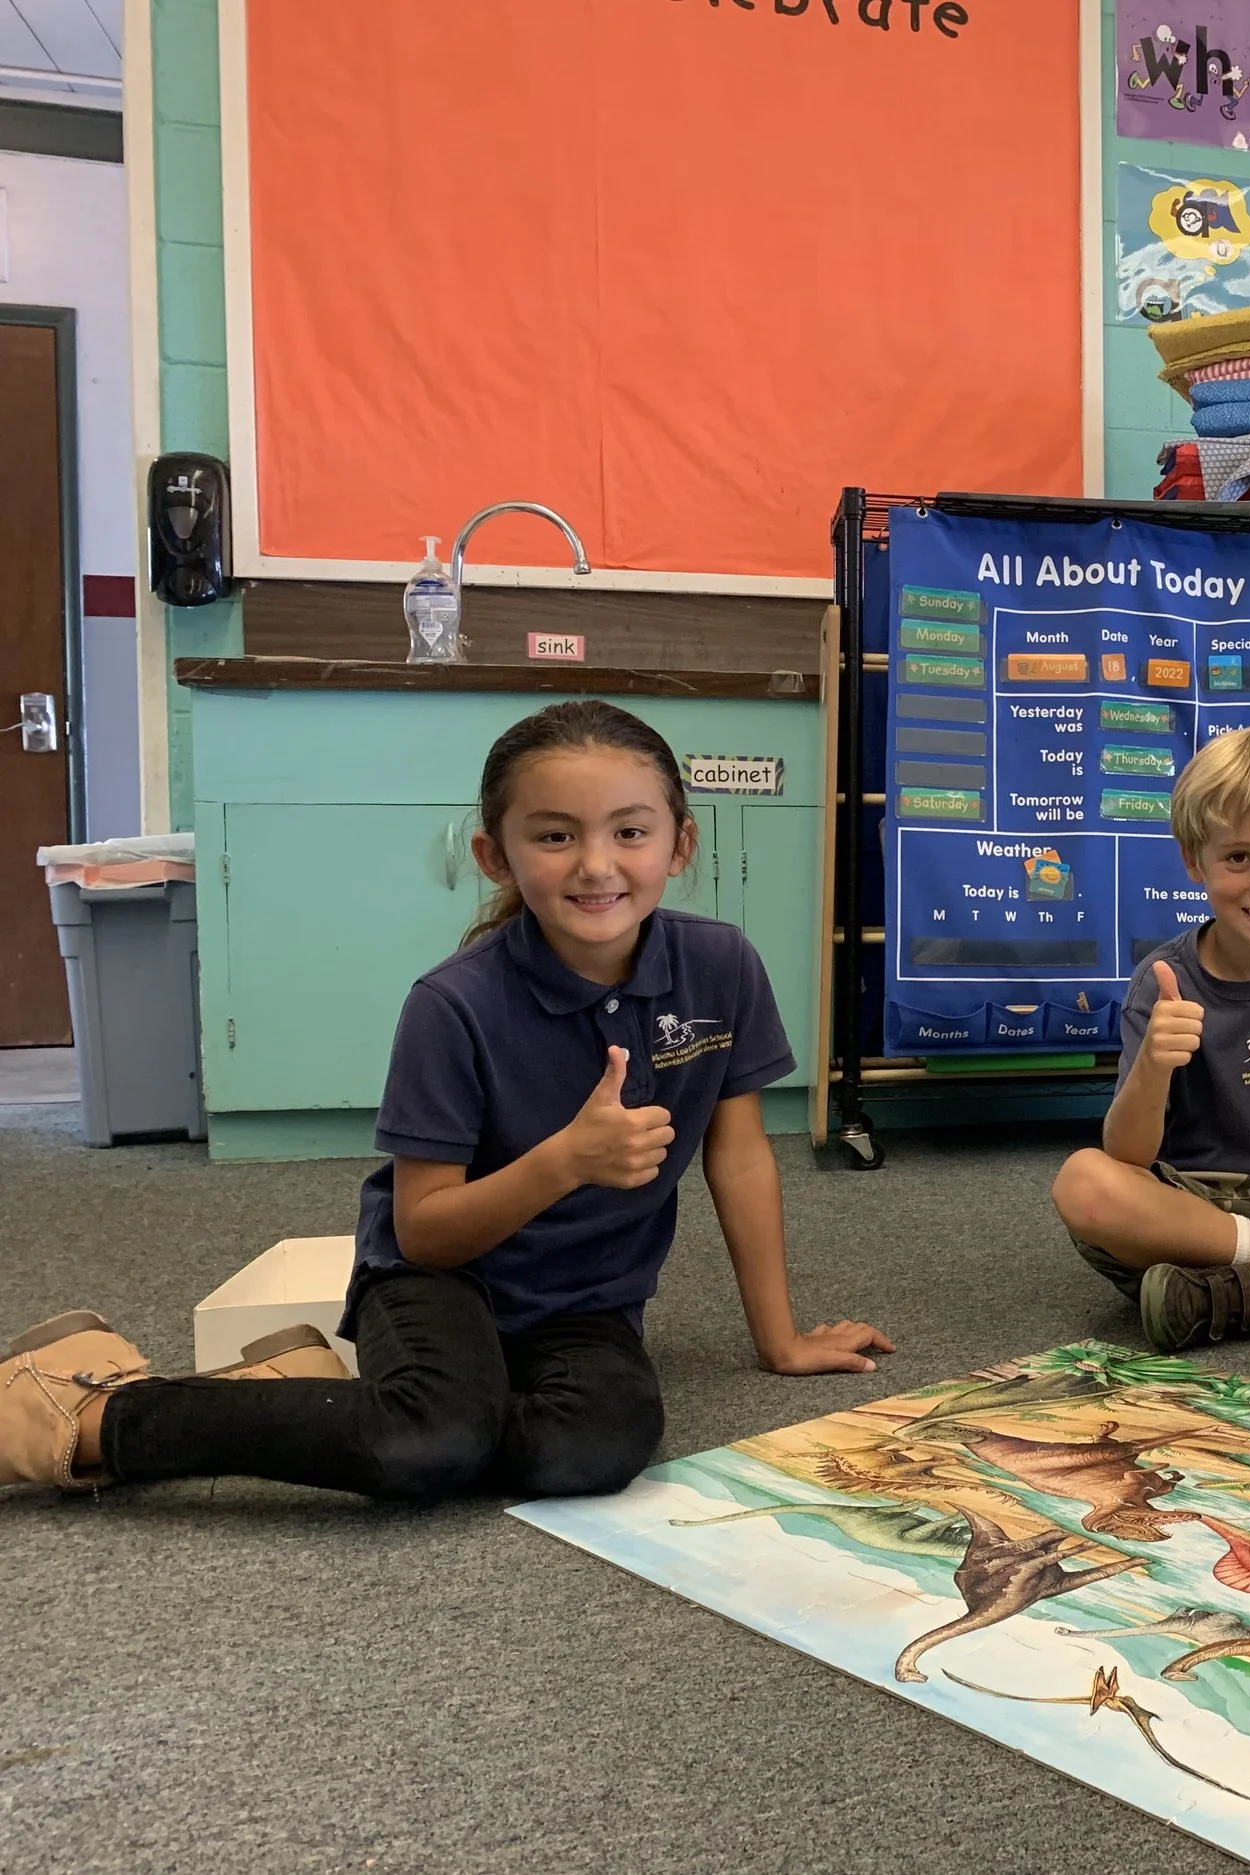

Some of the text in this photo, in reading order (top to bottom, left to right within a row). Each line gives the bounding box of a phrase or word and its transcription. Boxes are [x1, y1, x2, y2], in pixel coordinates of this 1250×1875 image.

[1140, 25, 1233, 96] wh
[977, 552, 1245, 606] All About Today
[919, 595, 963, 613] Sunday
[916, 628, 964, 645] Monday
[1026, 631, 1069, 643] Month
[1101, 629, 1128, 643] Date
[1149, 634, 1178, 647] Year
[537, 639, 575, 654] sink
[920, 663, 970, 679] Tuesday
[1040, 661, 1079, 674] August
[1155, 667, 1184, 680] 2022
[1010, 705, 1083, 720] Yesterday
[1109, 709, 1161, 725] Wednesday
[1055, 722, 1083, 733] was
[1040, 749, 1083, 763] Today
[1113, 752, 1162, 771] Thursday
[693, 764, 772, 783] cabinet
[1072, 763, 1083, 776] is
[913, 796, 969, 813] Saturday
[1010, 793, 1083, 806] Tomorrow
[1118, 798, 1155, 813] Friday
[1036, 808, 1084, 821] will be
[976, 840, 1052, 858] Weather
[963, 884, 1019, 901] Today is
[1144, 887, 1208, 901] The seaso
[933, 909, 1085, 922] M T W Th F
[1176, 912, 1210, 923] Words
[919, 1026, 969, 1040] Months
[999, 1023, 1035, 1037] Dates
[1064, 1023, 1099, 1036] Years
